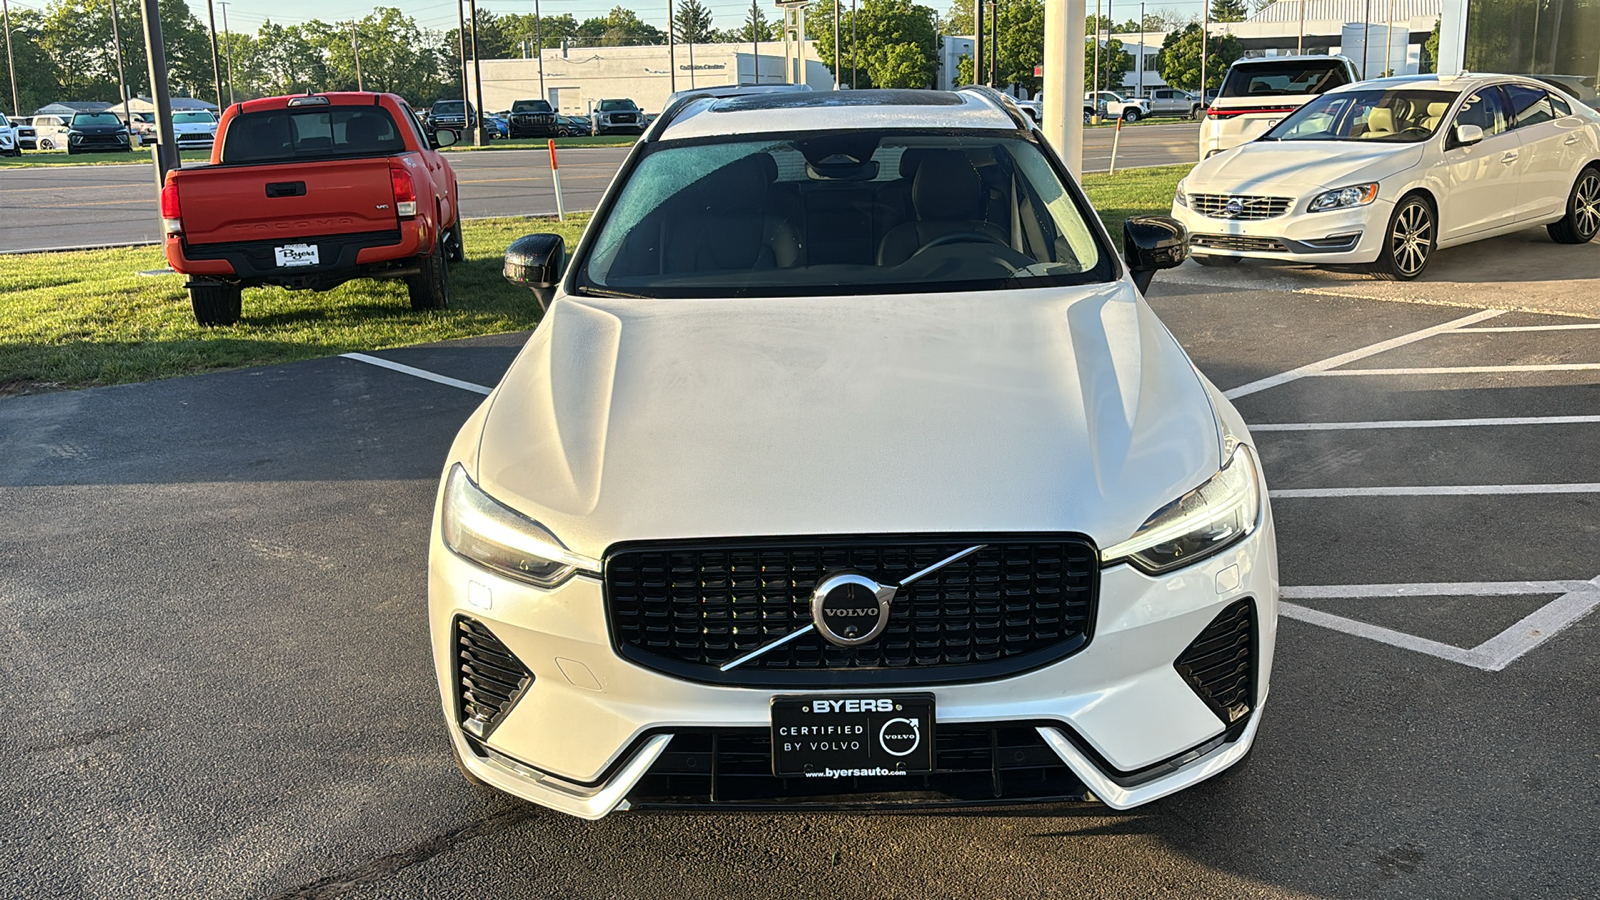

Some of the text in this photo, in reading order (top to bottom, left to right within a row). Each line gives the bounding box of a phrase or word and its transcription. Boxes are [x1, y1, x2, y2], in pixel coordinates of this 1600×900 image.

[232, 217, 354, 230] TACOMA
[278, 248, 315, 260] Byers
[824, 607, 879, 617] VOLVO
[812, 698, 894, 714] BYERS
[779, 725, 864, 736] CERTIFIED
[784, 741, 860, 752] BY VOLVO
[805, 766, 907, 779] www.byersauto.com
